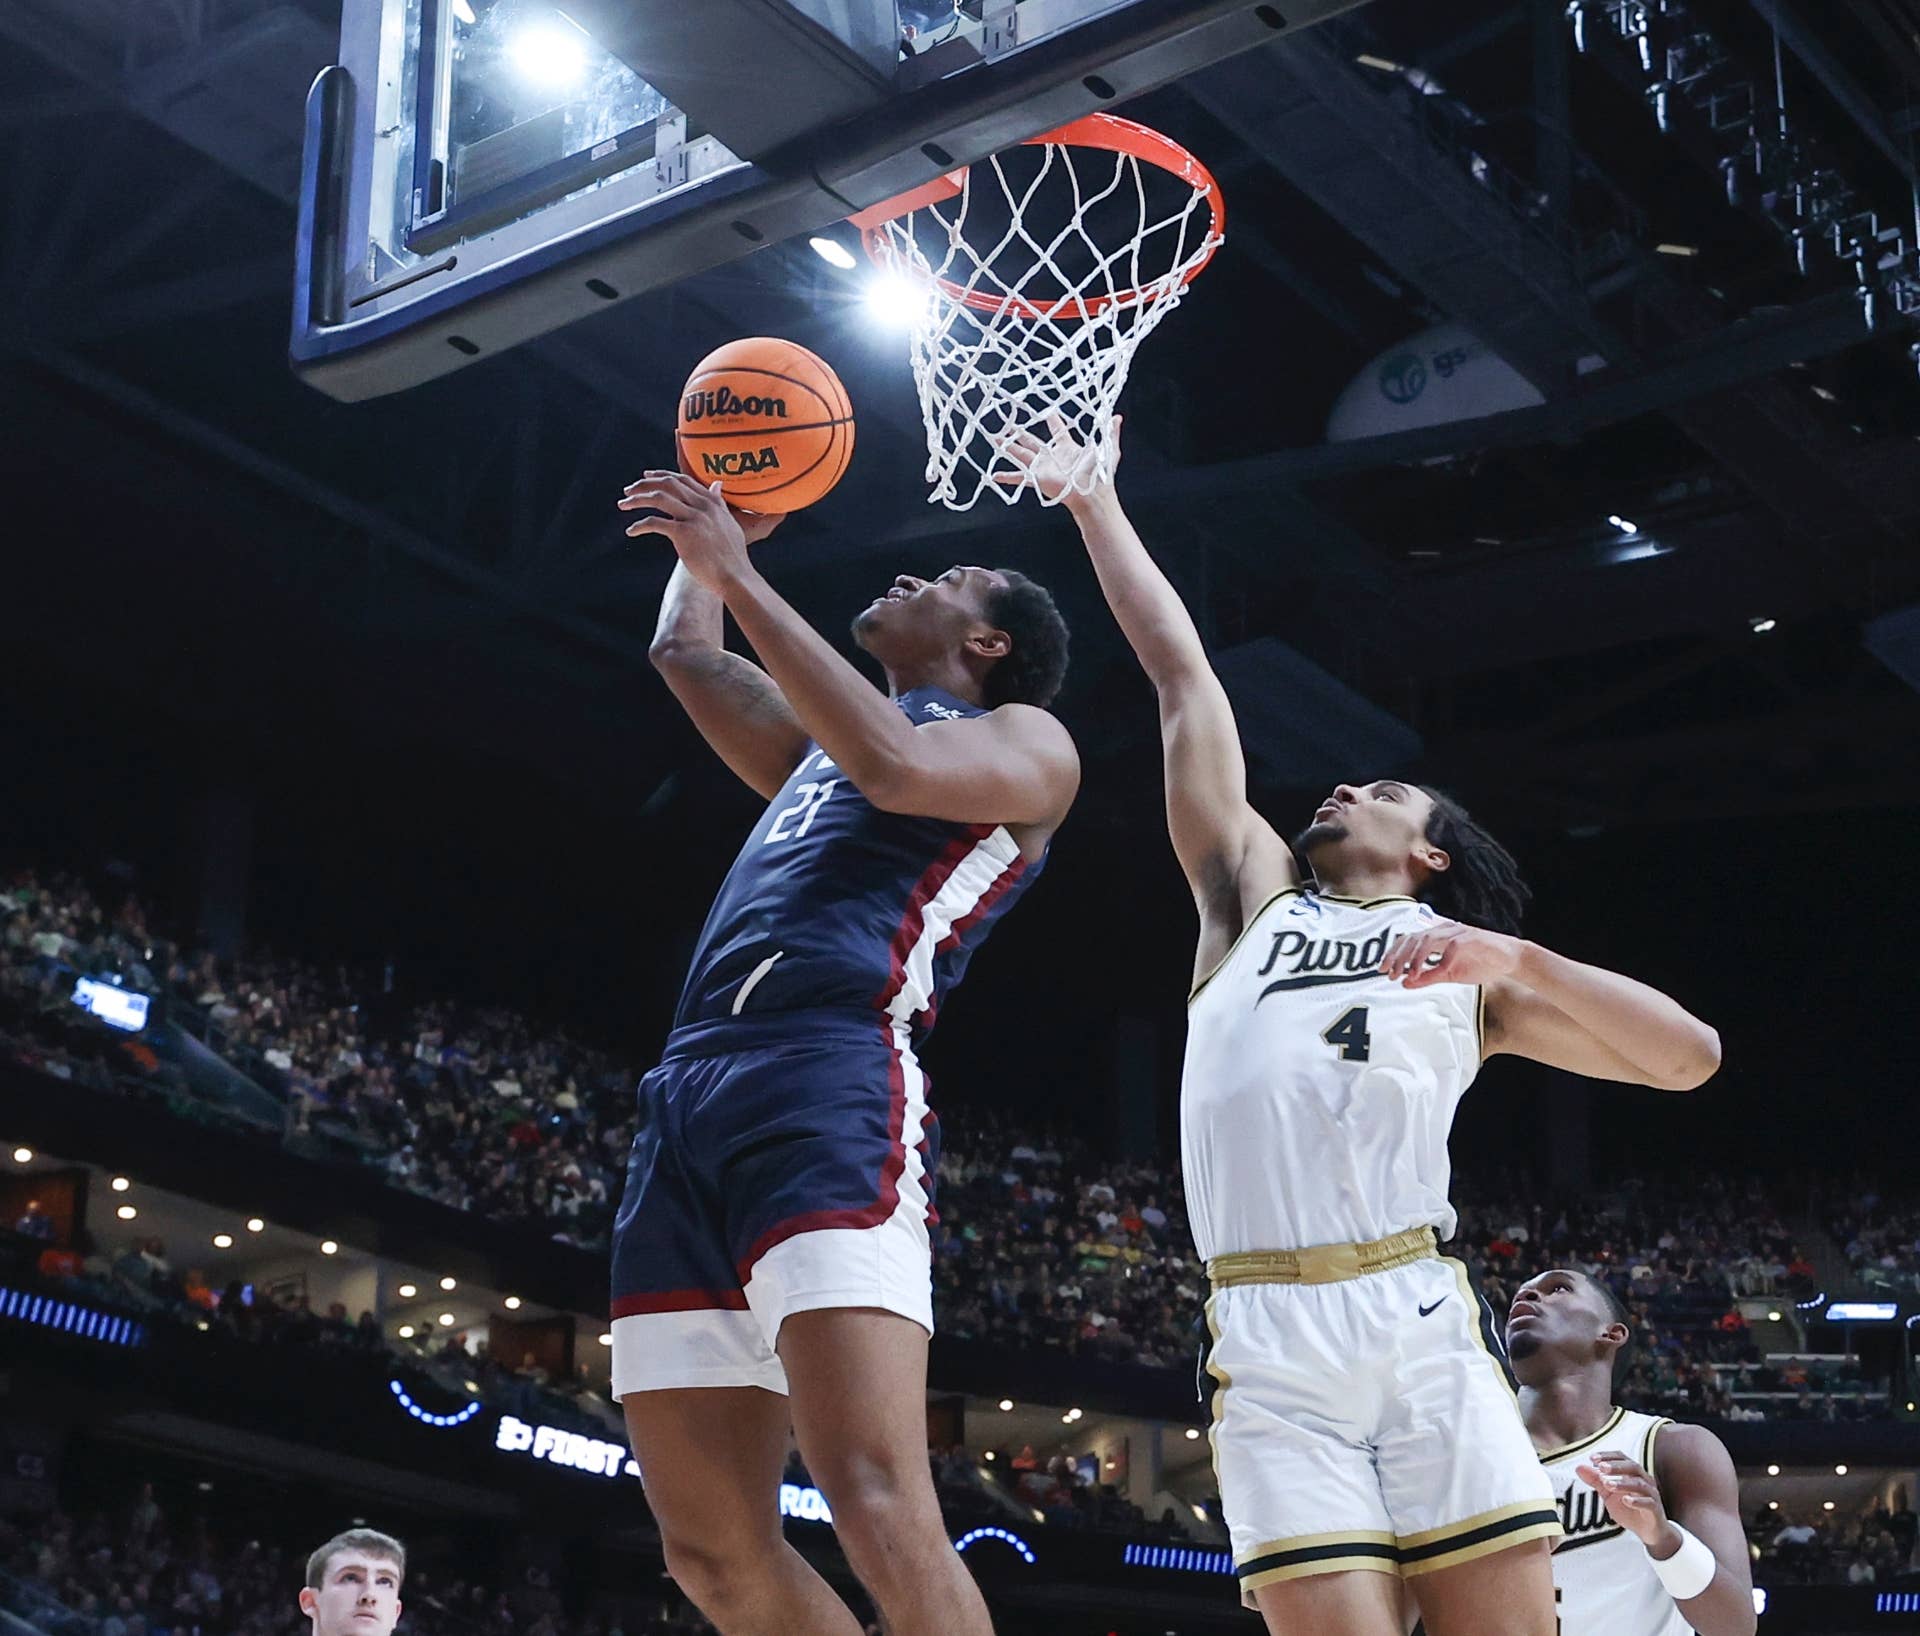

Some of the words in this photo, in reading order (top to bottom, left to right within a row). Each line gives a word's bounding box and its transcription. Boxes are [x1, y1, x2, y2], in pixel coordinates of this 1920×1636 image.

[685, 386, 788, 422] Wilson
[701, 446, 780, 475] NCAA
[763, 779, 838, 845] 21
[1257, 925, 1441, 976] Purd
[1320, 1003, 1371, 1063] 4
[533, 1426, 626, 1477] FIRST
